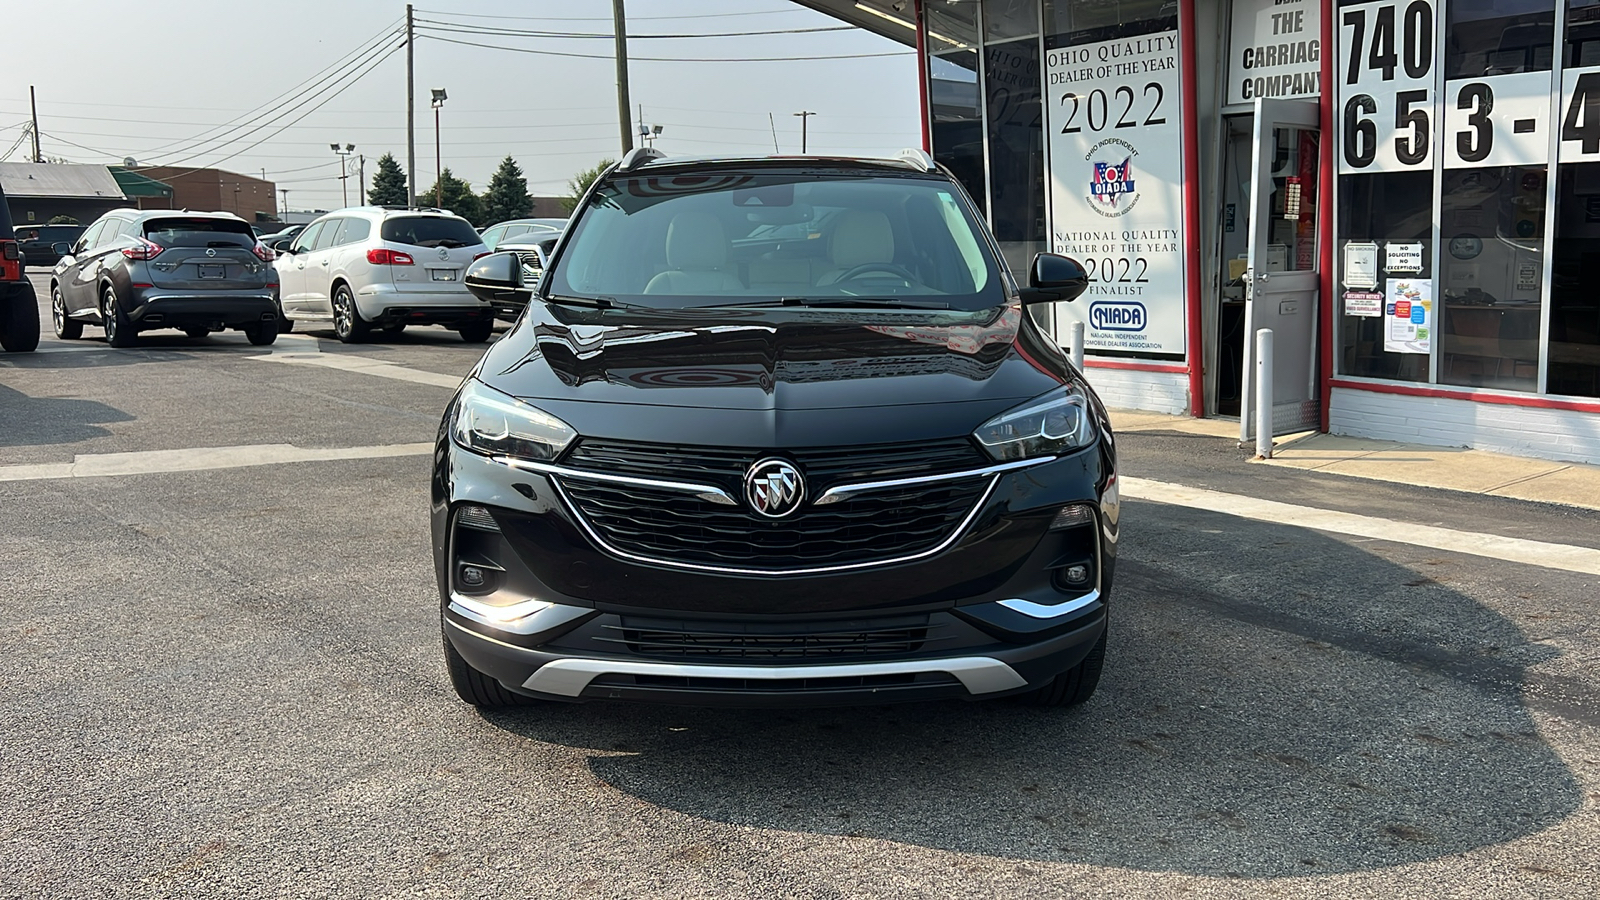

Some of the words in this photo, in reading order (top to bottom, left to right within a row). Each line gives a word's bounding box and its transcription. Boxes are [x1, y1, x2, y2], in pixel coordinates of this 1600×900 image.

[1271, 10, 1304, 36] THE
[1048, 48, 1090, 68] OHIO
[1098, 34, 1177, 62] QUALITY
[1242, 39, 1320, 70] CARRIAG
[1343, 0, 1433, 86] 740
[1050, 68, 1094, 85] DEALER
[1096, 65, 1112, 79] OF
[1114, 61, 1139, 76] THE
[1141, 56, 1175, 73] YEAR
[1060, 82, 1166, 134] 2022
[1085, 144, 1099, 161] OHIO
[1098, 137, 1140, 157] INDEPENDENT
[1095, 182, 1128, 194] OIADA
[1055, 231, 1117, 242] NATIONAL
[1121, 229, 1179, 242] QUALITY
[1056, 244, 1098, 254] DEALER
[1101, 244, 1116, 253] OF
[1120, 243, 1142, 253] THE
[1146, 243, 1178, 252] YEAR
[1085, 257, 1149, 283] 2022
[1089, 286, 1144, 296] FINALIST
[1093, 307, 1141, 325] NIADA
